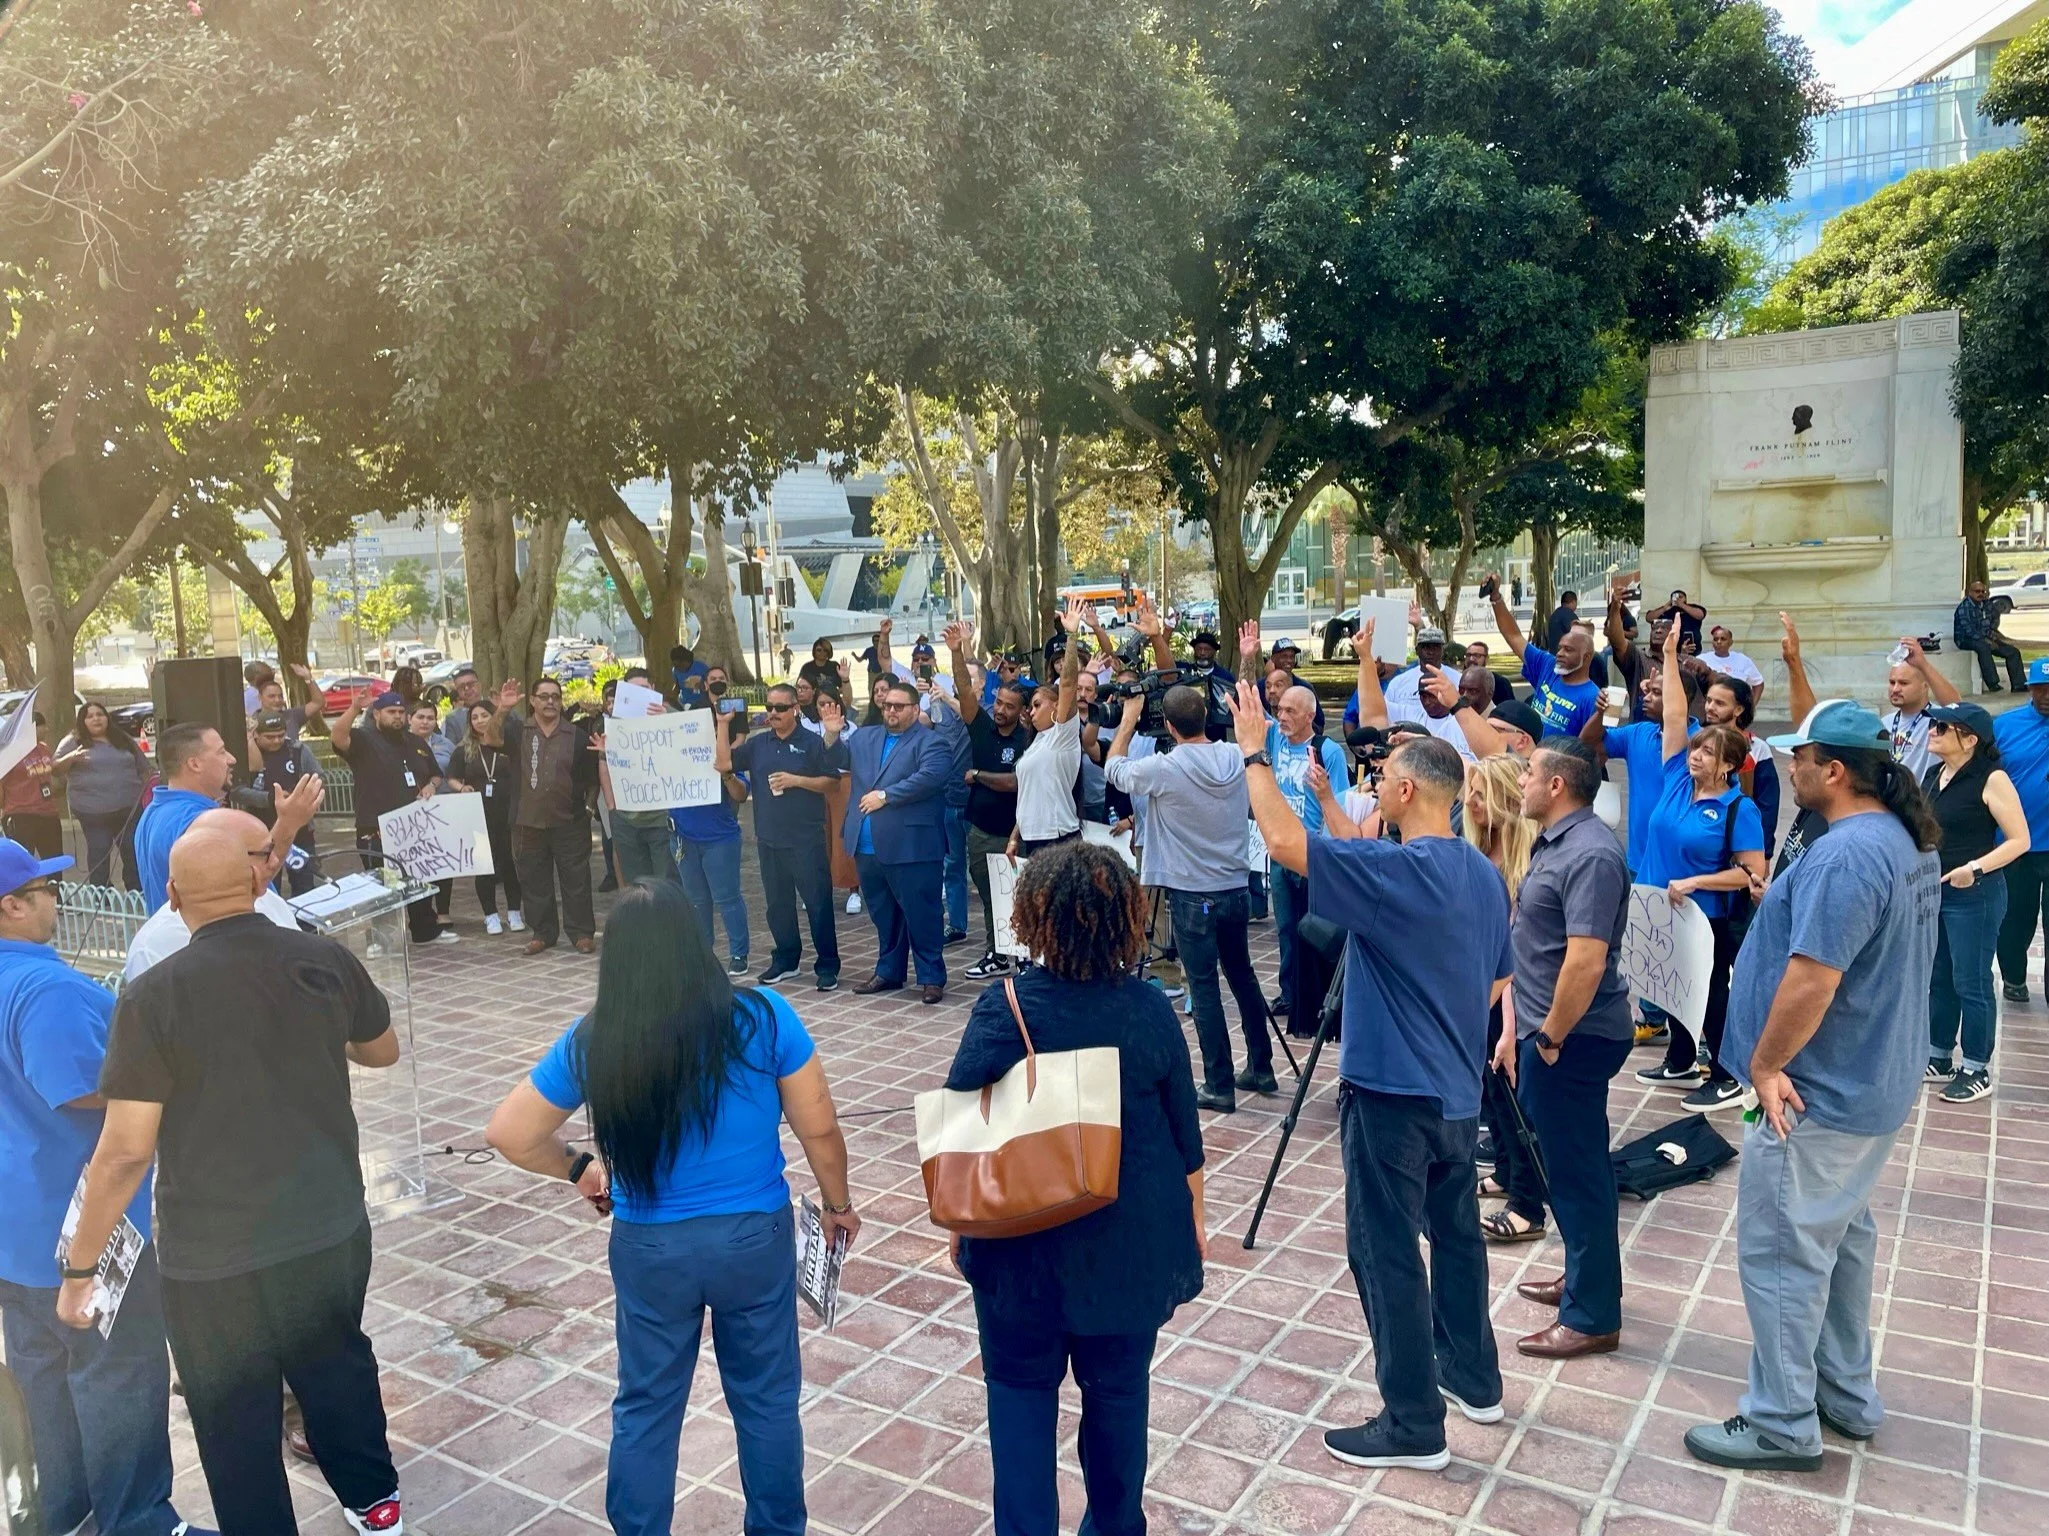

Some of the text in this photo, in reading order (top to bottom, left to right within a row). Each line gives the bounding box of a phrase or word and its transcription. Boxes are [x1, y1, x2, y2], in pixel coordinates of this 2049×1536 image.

[1749, 438, 1854, 452] FRANK PUTNAM FLINT
[617, 724, 675, 755] Support
[640, 754, 658, 778] LA
[621, 776, 712, 805] Peace Makers
[386, 804, 450, 847] BLACK
[805, 1219, 820, 1291] URBAN
